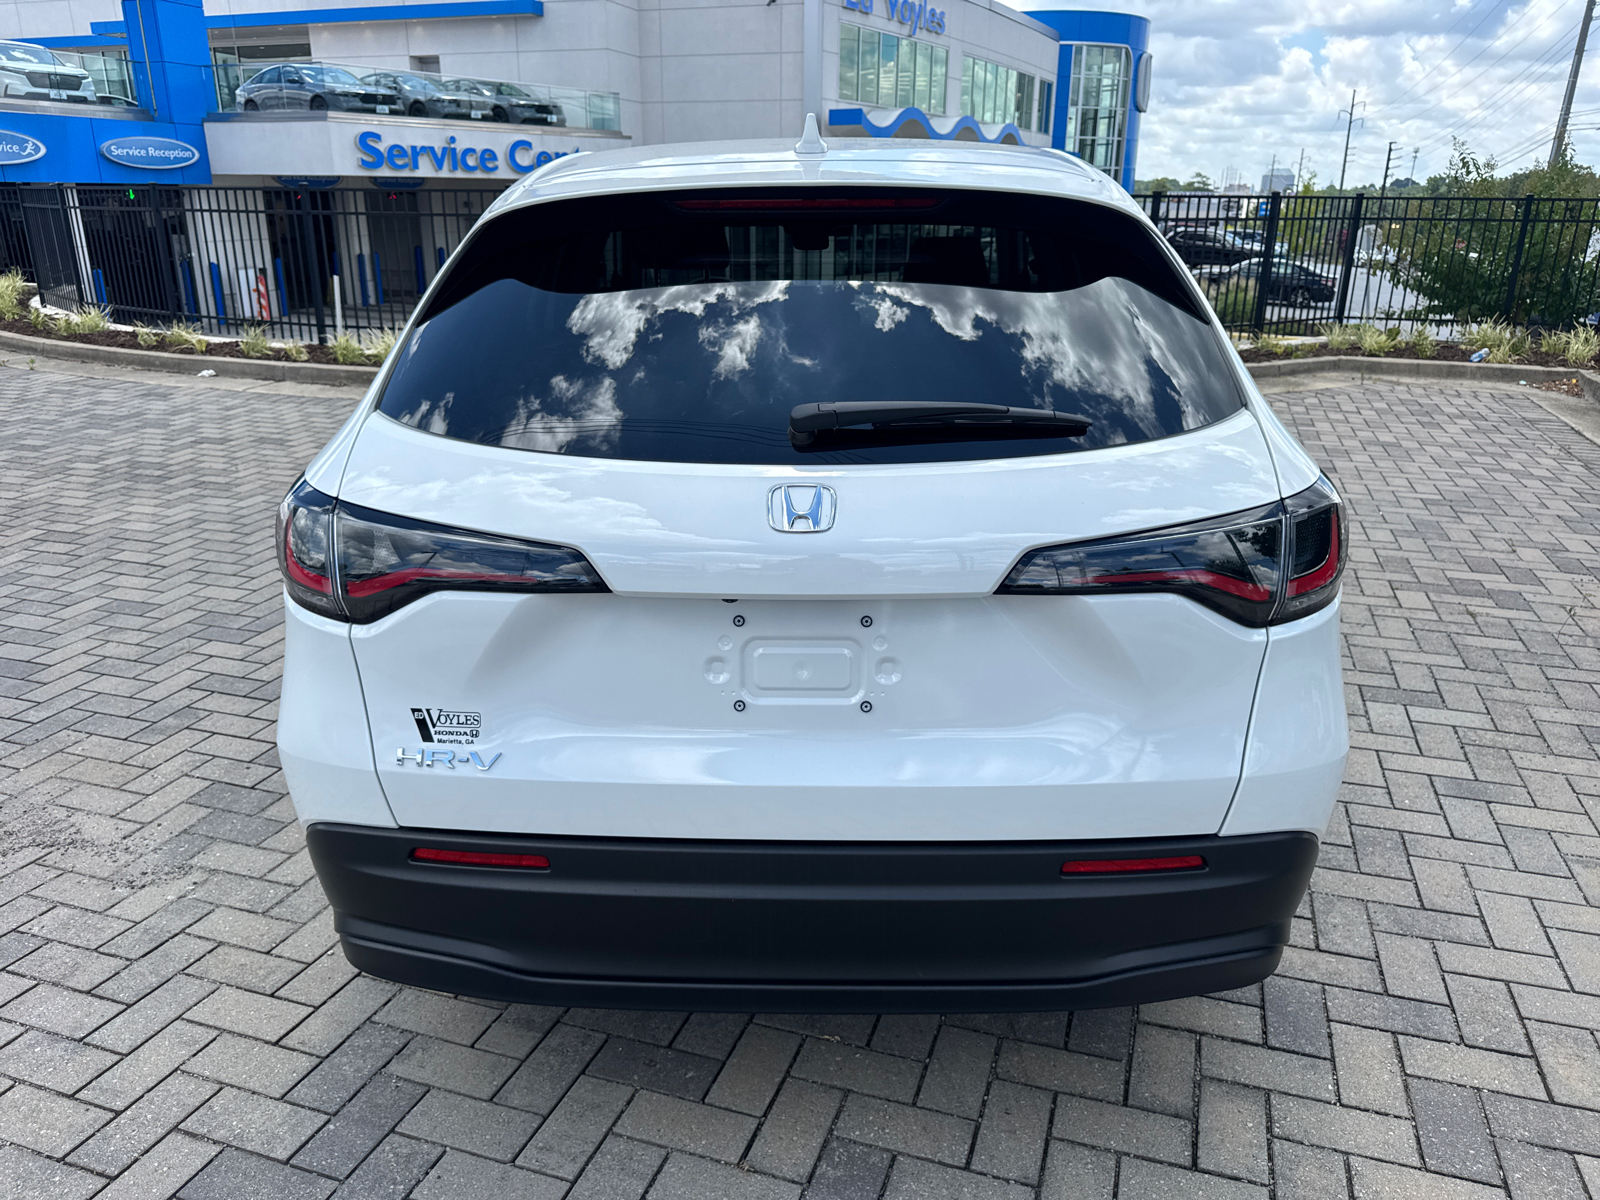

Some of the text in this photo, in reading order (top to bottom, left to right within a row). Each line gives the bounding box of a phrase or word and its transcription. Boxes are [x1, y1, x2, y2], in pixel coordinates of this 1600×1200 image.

[887, 0, 946, 36] Voyles
[110, 145, 193, 160] Service Reception
[356, 131, 580, 174] Service Ce
[425, 708, 480, 729] VOYLES
[396, 747, 503, 771] HR-V
